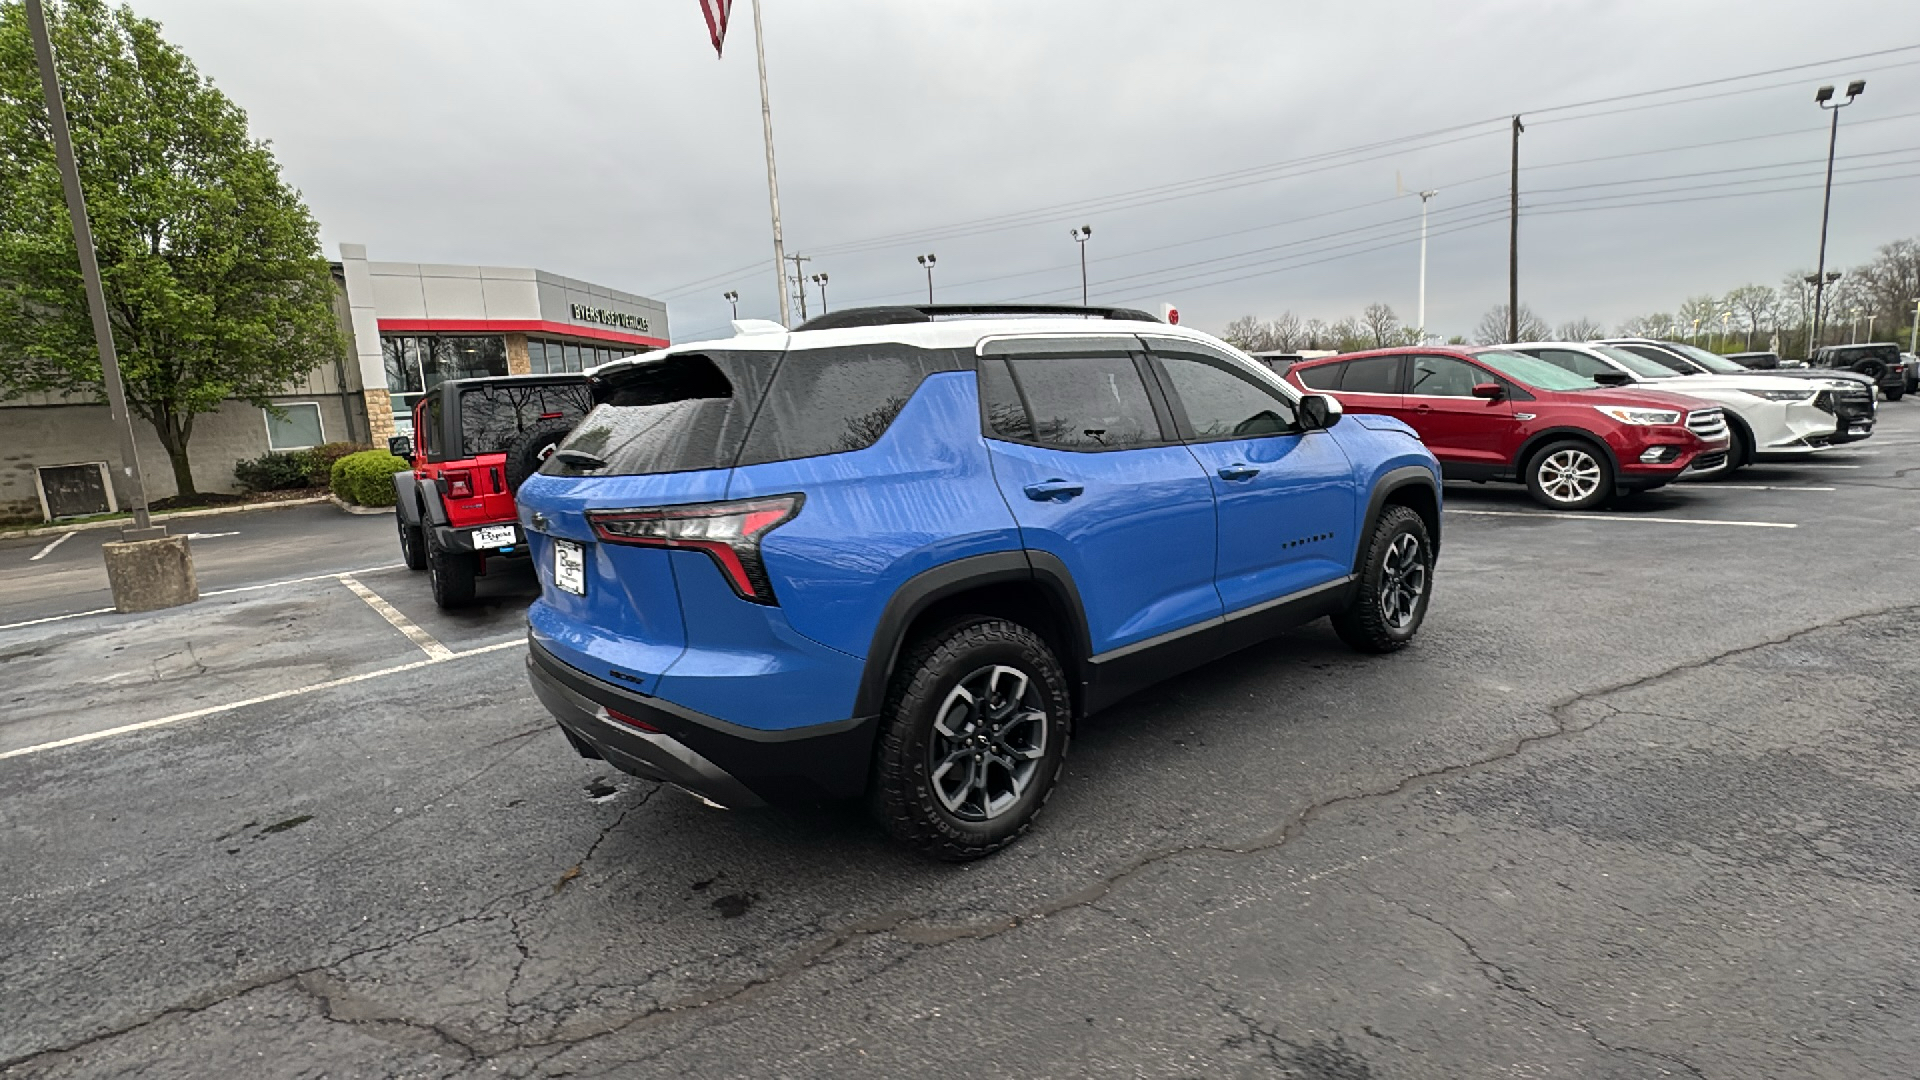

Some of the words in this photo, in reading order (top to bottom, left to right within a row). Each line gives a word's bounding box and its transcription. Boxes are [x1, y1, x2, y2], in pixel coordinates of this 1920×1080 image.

[572, 303, 600, 323] BYERS
[601, 309, 620, 326] USED
[620, 314, 648, 331] VEHICLES
